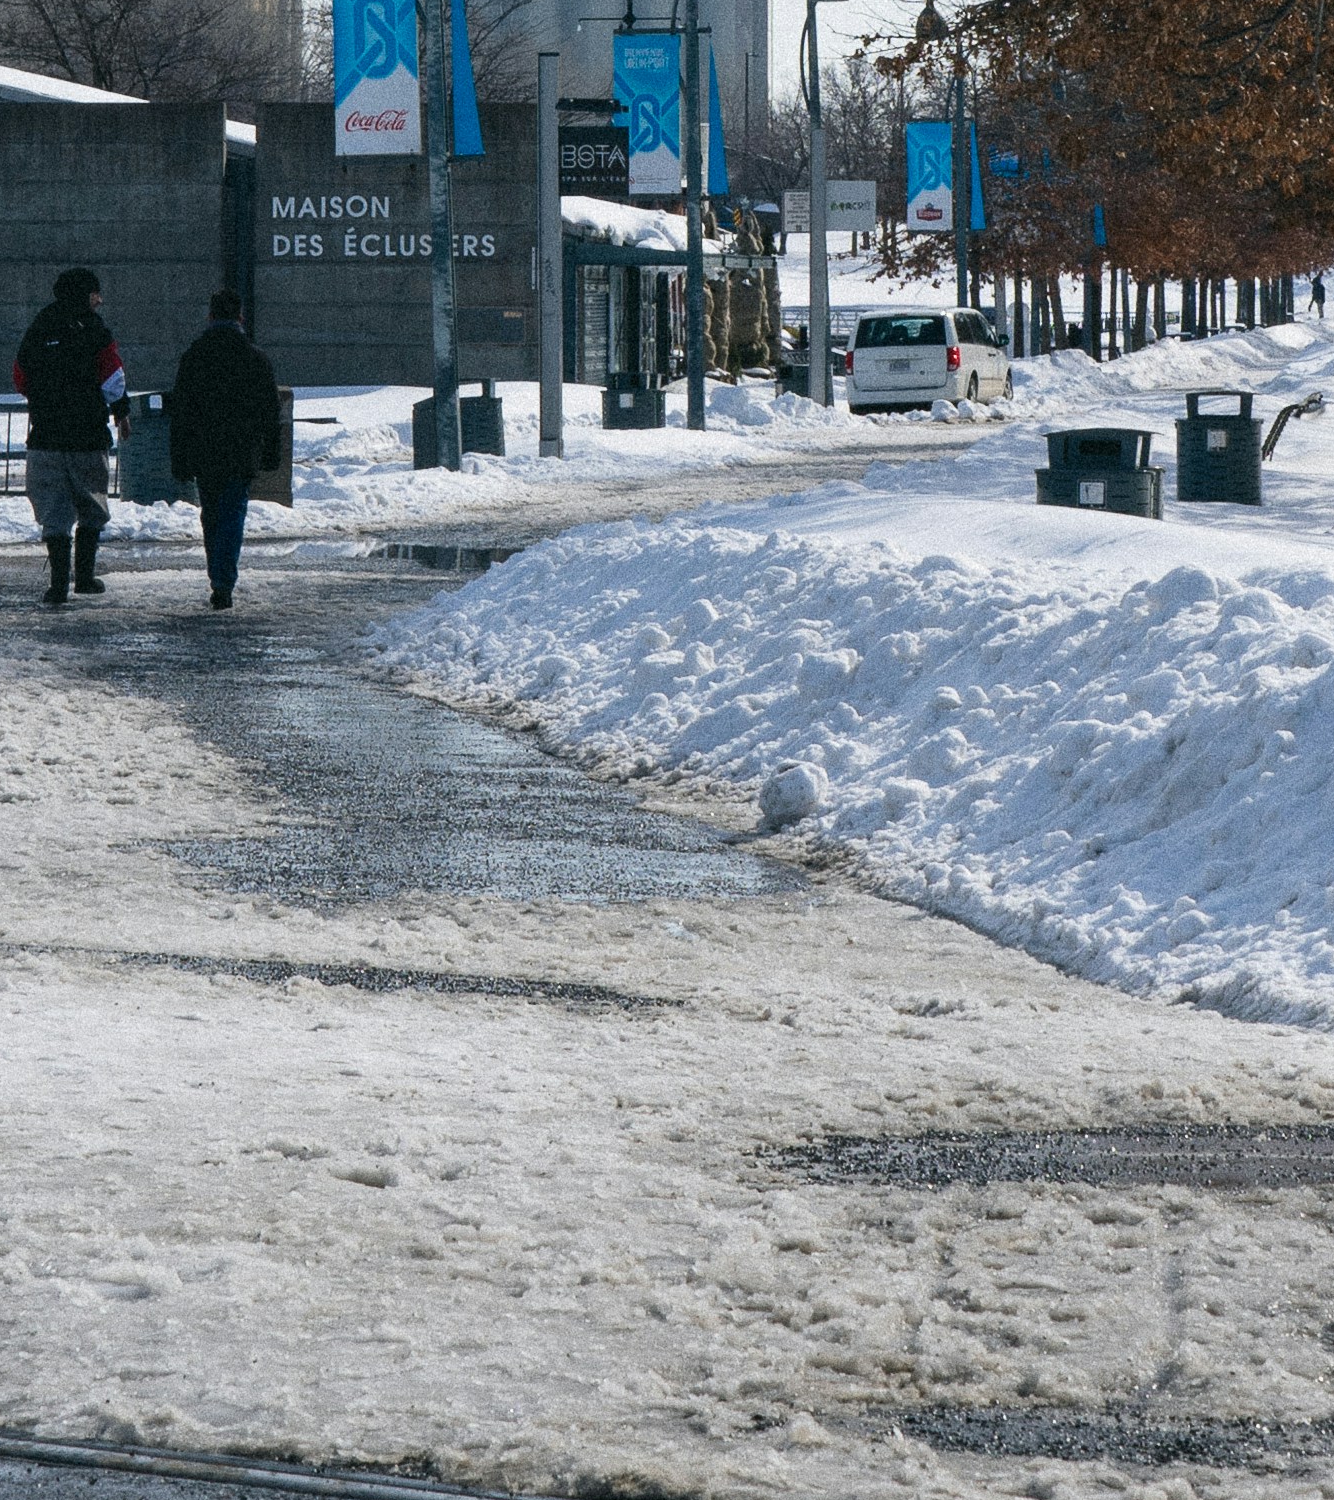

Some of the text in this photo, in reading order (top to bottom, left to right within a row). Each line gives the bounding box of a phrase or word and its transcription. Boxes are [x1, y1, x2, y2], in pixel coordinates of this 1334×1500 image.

[345, 109, 409, 132] Coca-Cola
[561, 144, 626, 169] BOTA
[272, 195, 390, 219] MAISON
[273, 227, 496, 257] DES ÉCLUSERS
